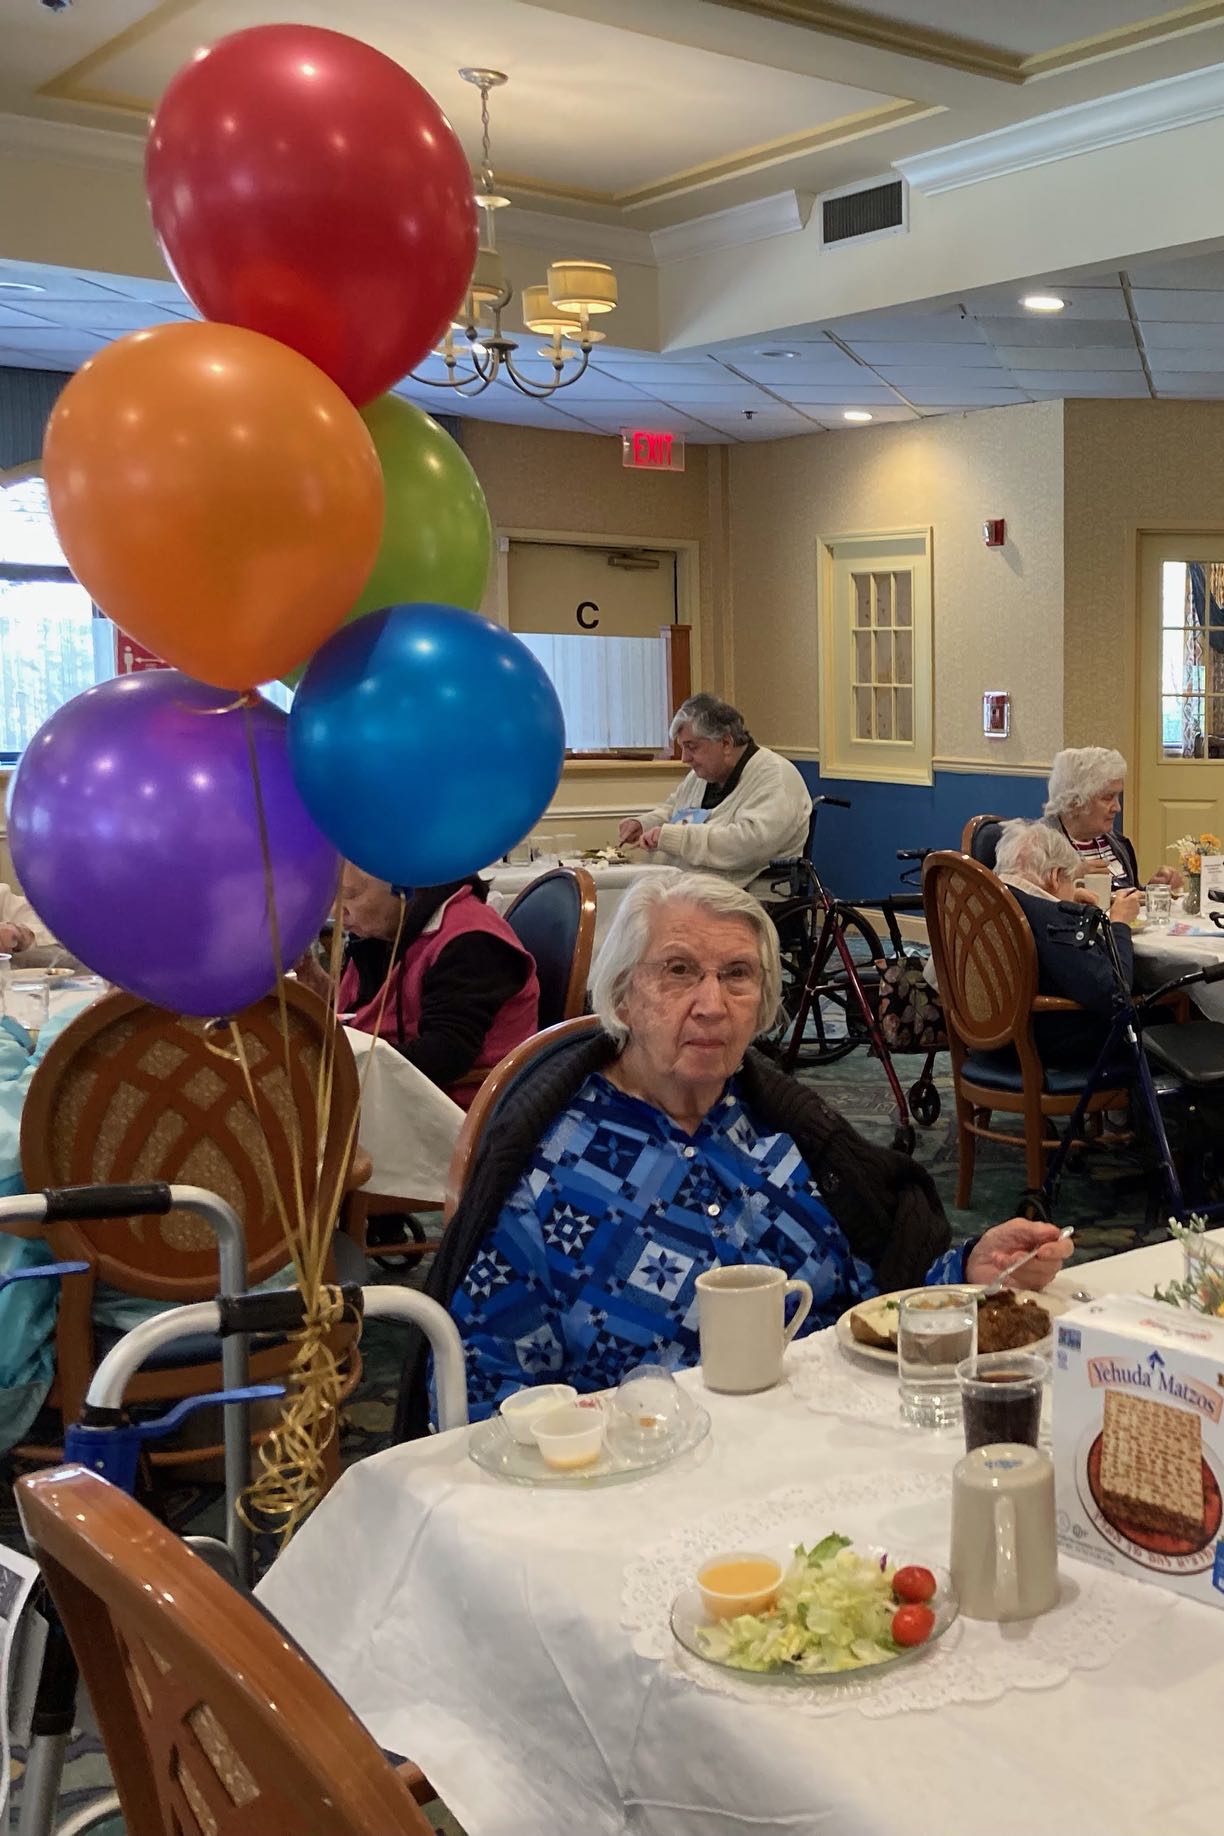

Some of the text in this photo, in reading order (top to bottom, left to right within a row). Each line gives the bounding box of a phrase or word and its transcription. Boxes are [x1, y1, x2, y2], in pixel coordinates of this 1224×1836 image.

[633, 431, 674, 466] EXIT
[576, 601, 600, 629] C
[1092, 1361, 1217, 1414] Yehuda Matzos
